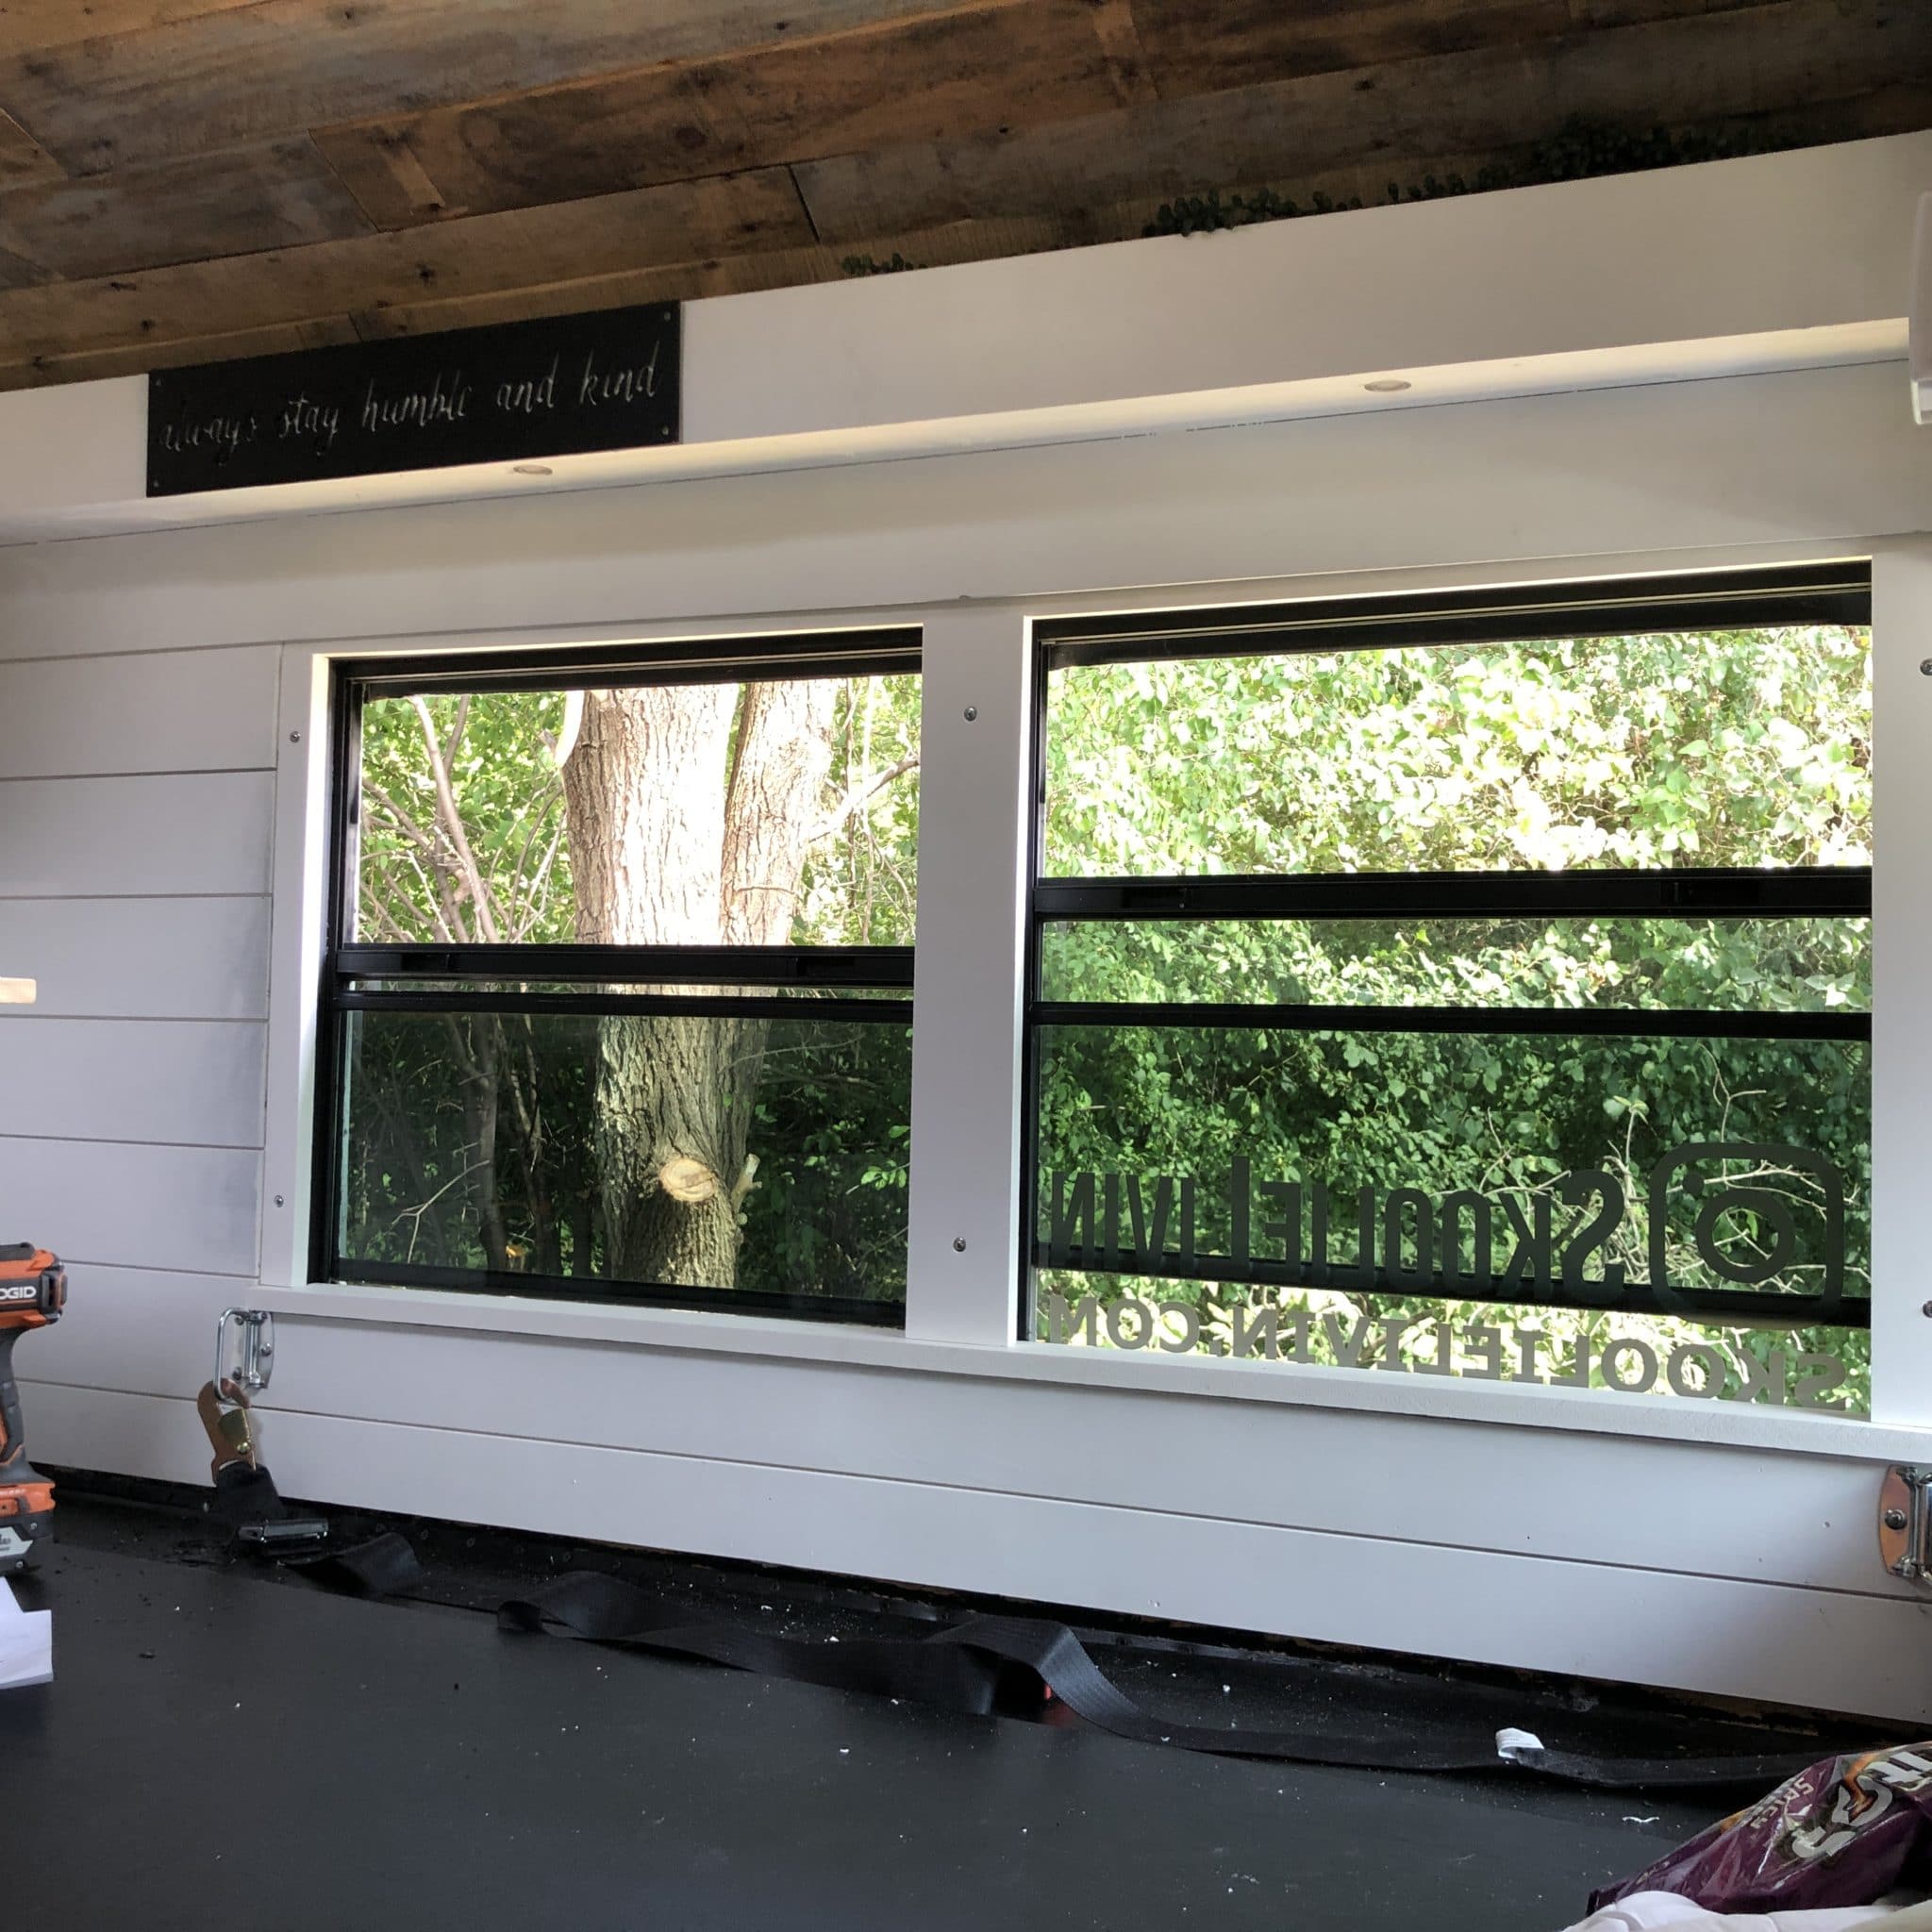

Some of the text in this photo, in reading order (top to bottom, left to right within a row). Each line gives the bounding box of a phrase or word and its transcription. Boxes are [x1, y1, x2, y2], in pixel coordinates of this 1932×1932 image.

[278, 391, 339, 457] stay
[362, 370, 472, 432] humble
[497, 351, 559, 413] and
[577, 340, 659, 406] kind
